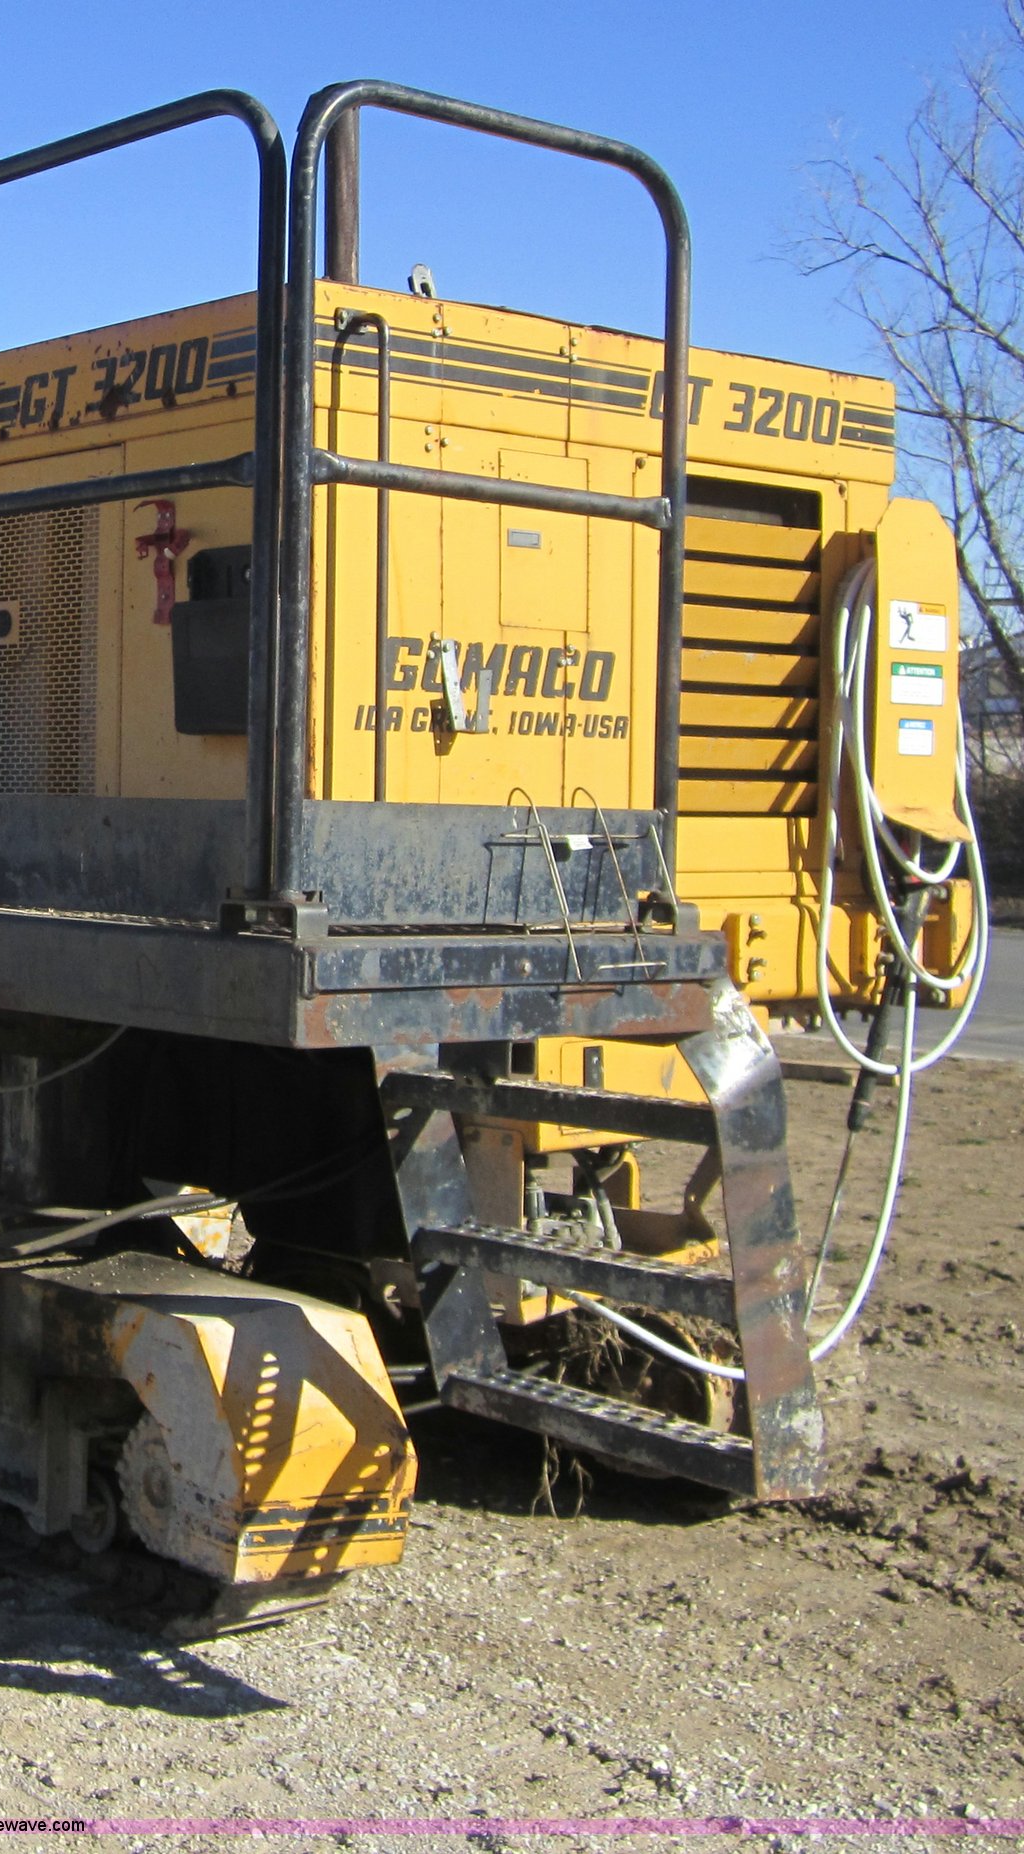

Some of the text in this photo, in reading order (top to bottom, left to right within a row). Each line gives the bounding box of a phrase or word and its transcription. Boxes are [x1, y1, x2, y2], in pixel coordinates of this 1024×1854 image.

[19, 336, 209, 427] GT 3200
[723, 382, 841, 445] 3200
